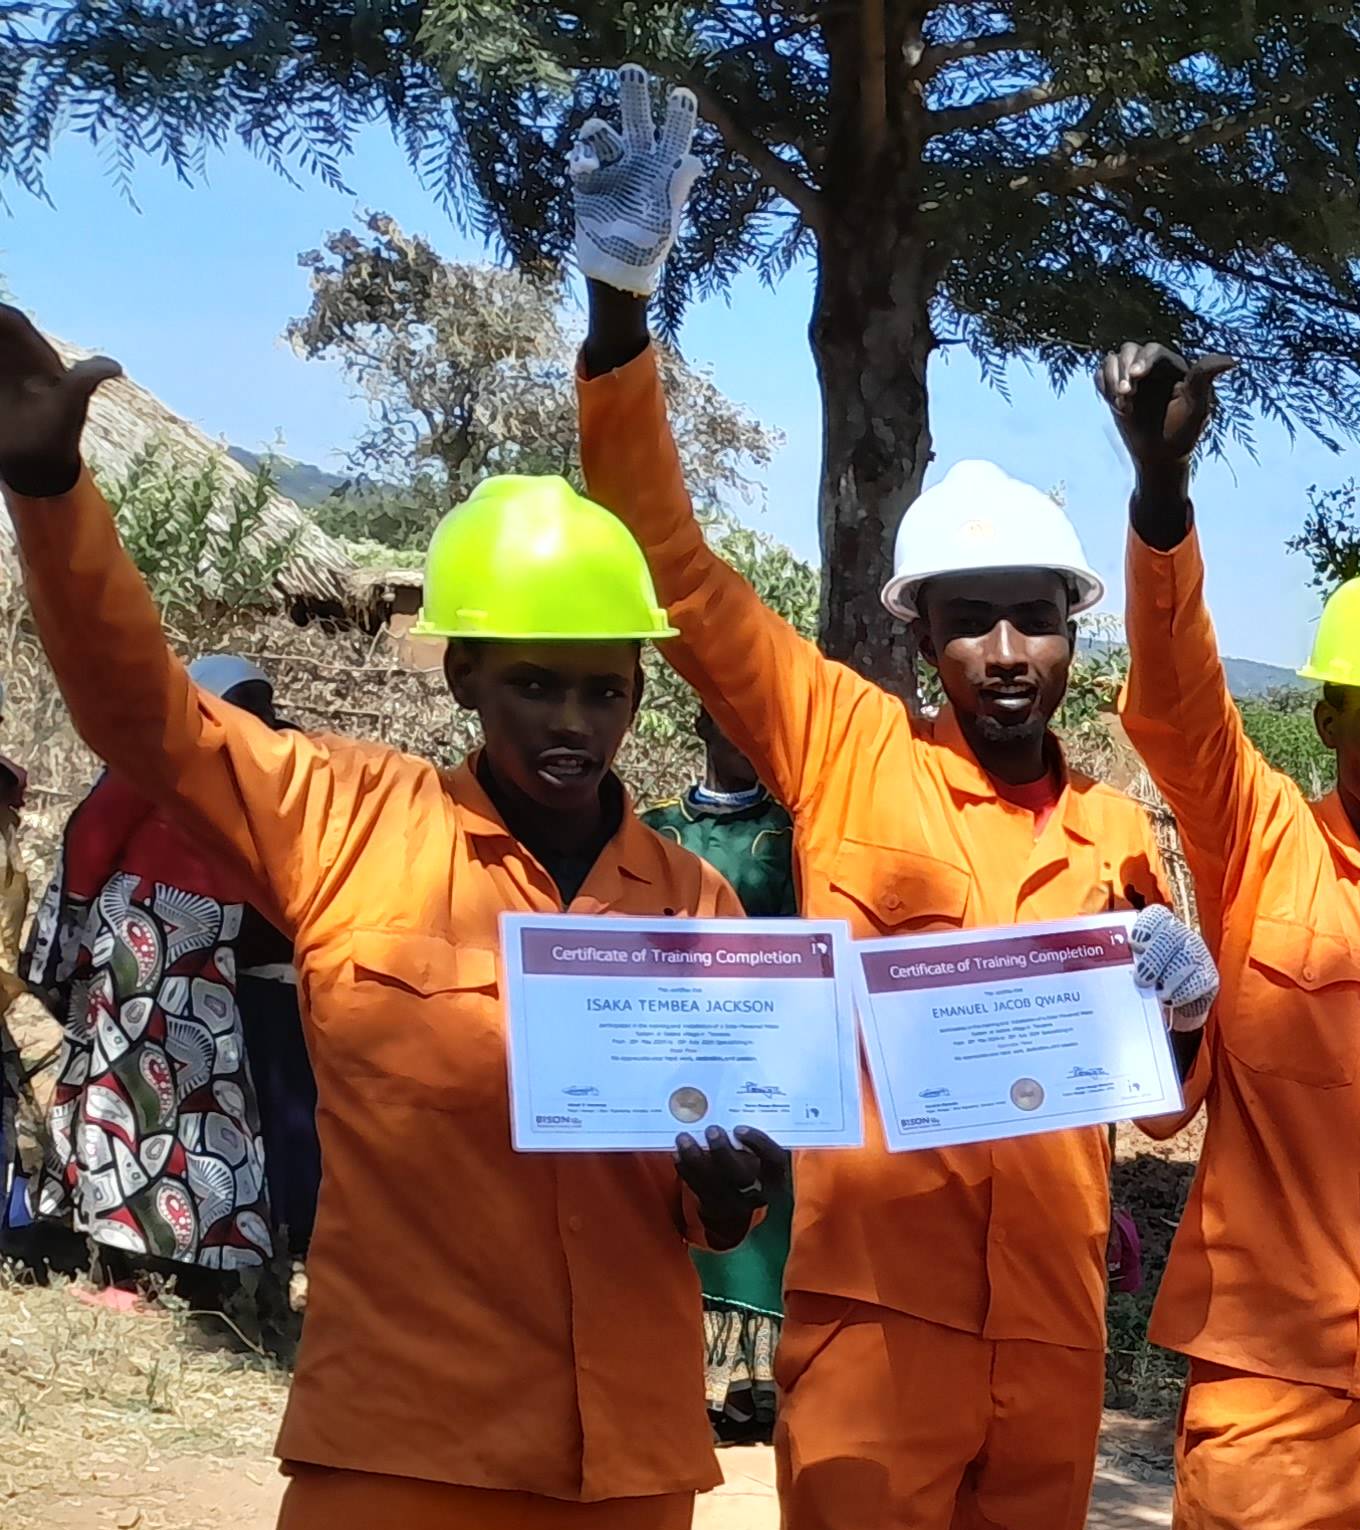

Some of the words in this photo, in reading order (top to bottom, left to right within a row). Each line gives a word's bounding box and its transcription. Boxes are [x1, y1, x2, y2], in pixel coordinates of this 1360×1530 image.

[552, 947, 628, 963] Certificate
[631, 948, 646, 962] of
[652, 949, 712, 967] Training
[716, 950, 801, 967] Completion
[890, 962, 955, 979] Certificate
[958, 959, 970, 972] of
[974, 954, 1026, 970] Training
[1030, 945, 1103, 963] Completion
[587, 999, 632, 1012] ISAKA
[639, 1000, 700, 1012] TEMBEA
[706, 1000, 774, 1012] JACKSON
[933, 1003, 988, 1018] EMANUEL
[994, 998, 1031, 1012] JACOB
[1035, 992, 1081, 1009] QWARU
